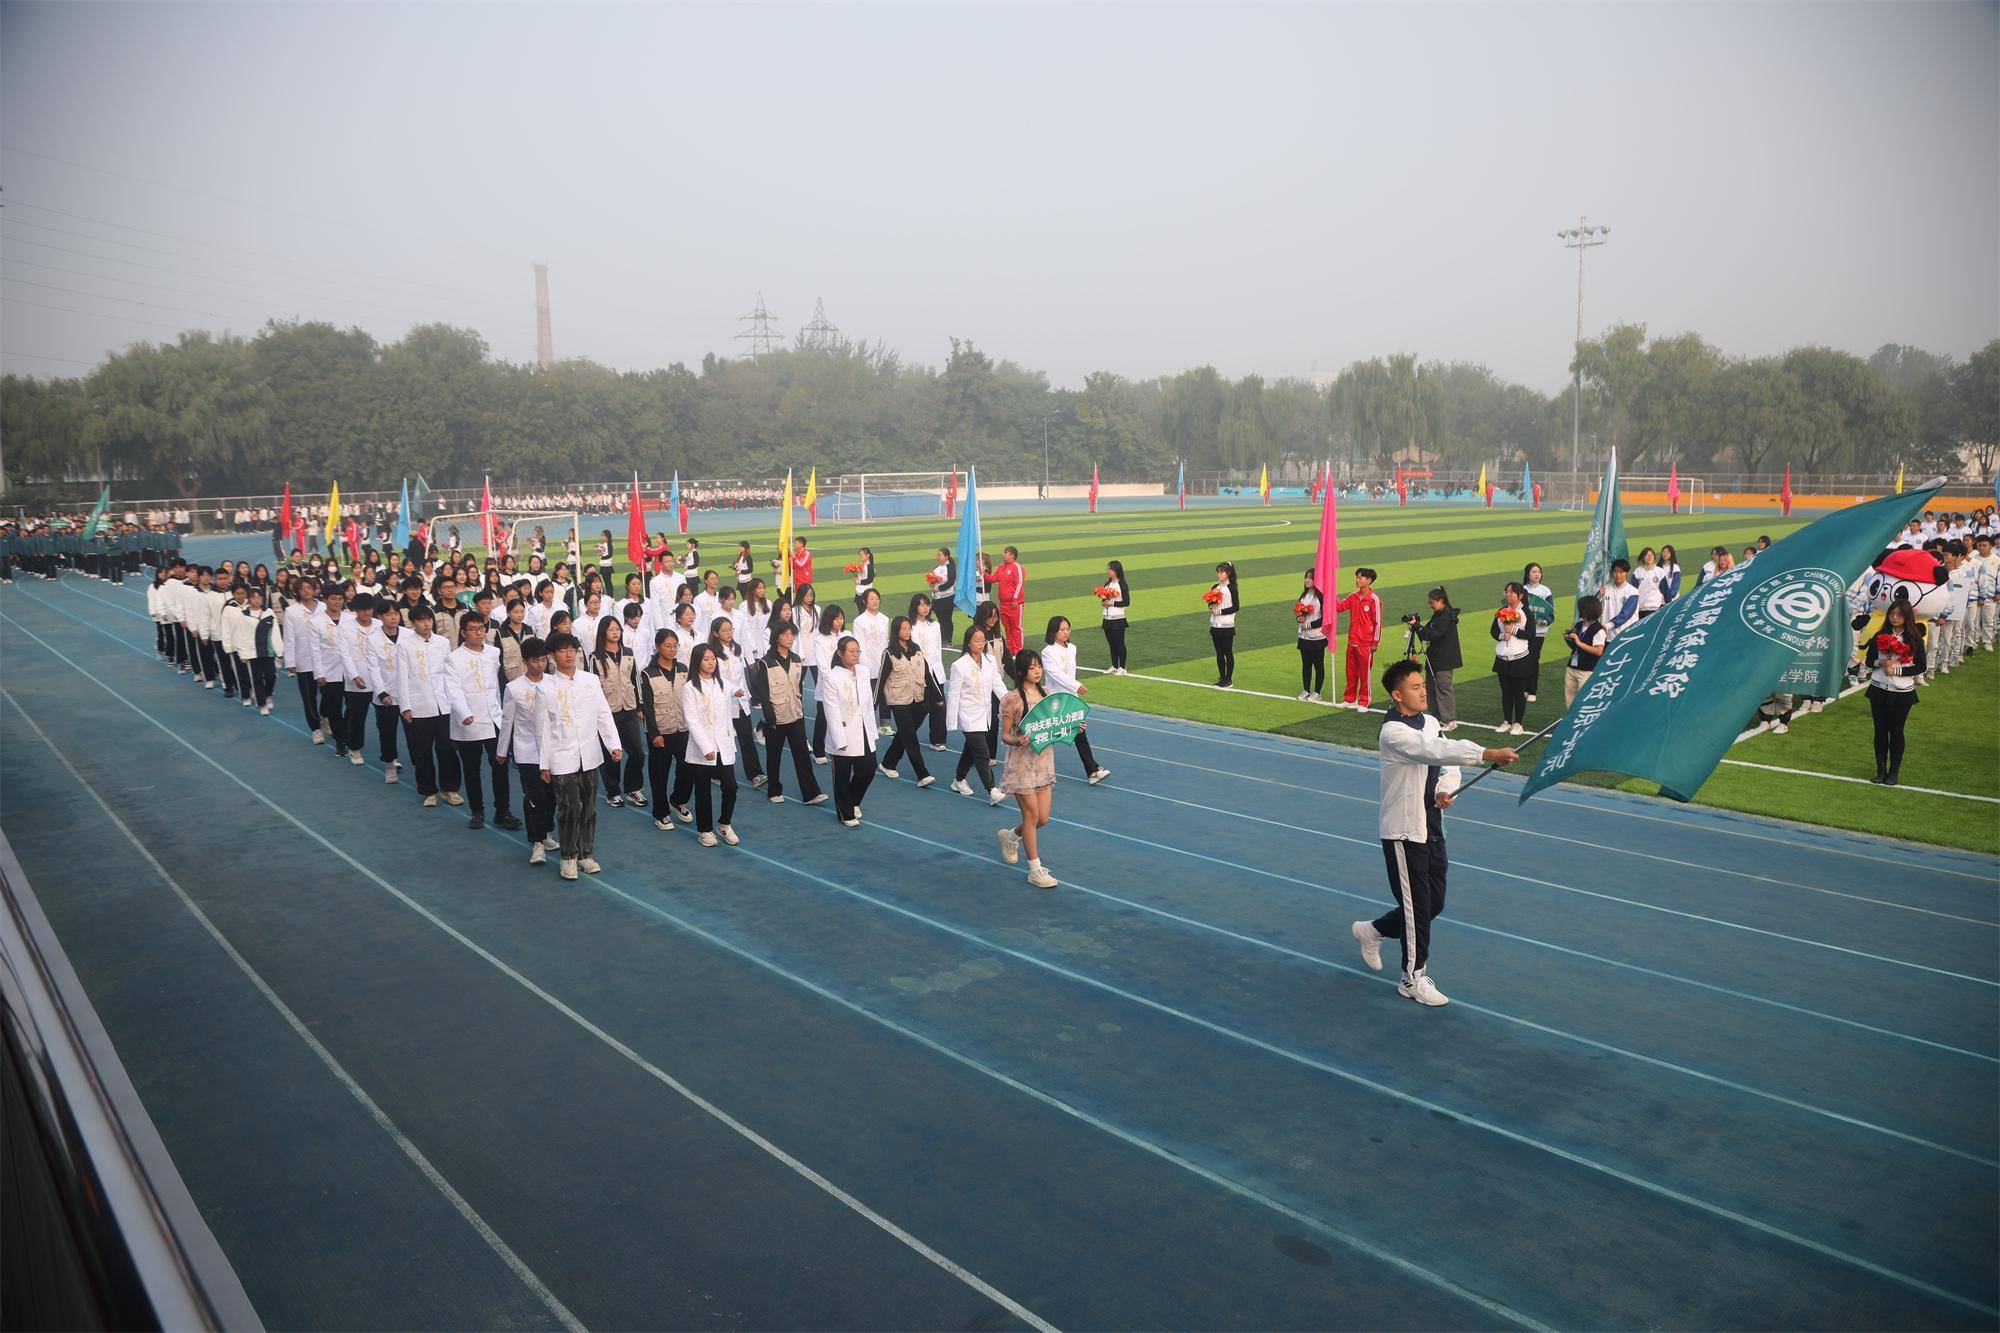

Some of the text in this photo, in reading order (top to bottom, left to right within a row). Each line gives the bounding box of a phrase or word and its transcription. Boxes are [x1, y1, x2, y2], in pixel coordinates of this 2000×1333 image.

[1804, 571, 1829, 581] CHINA
[1540, 617, 1652, 777] 人力资源学院
[1024, 709, 1085, 735] 劳动关系与人力资源
